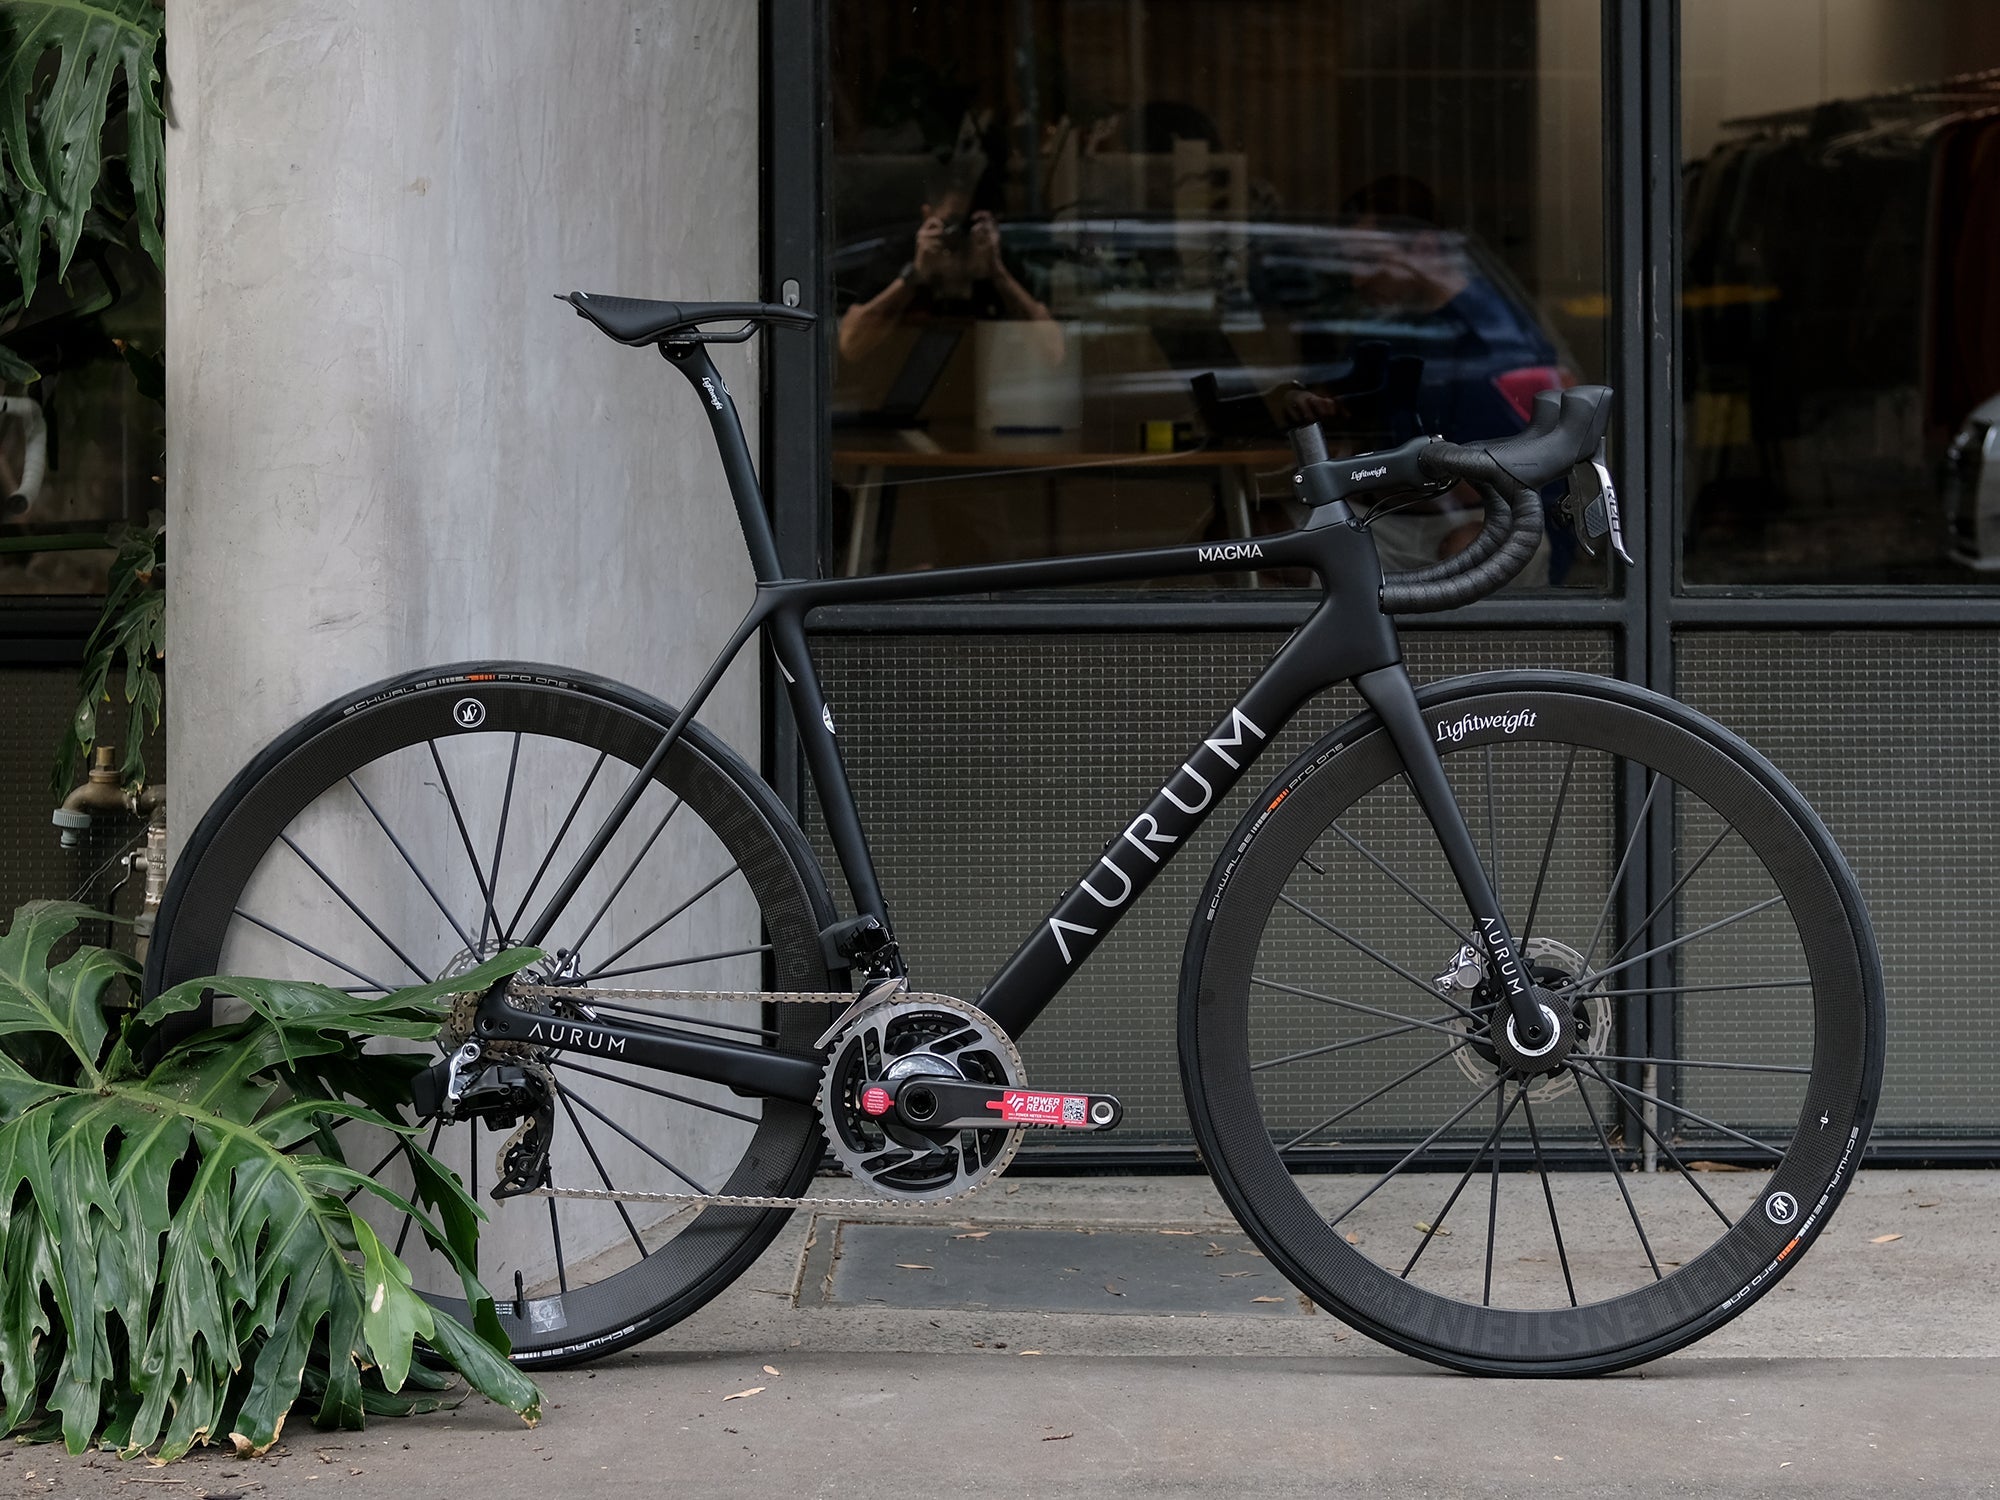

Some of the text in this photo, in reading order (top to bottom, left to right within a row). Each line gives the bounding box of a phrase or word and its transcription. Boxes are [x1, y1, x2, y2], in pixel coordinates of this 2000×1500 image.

[1350, 466, 1387, 482] Lightweight
[1198, 543, 1263, 562] MAGMA
[1436, 708, 1537, 742] Lightweight
[1049, 706, 1267, 965] AURUM
[1480, 917, 1525, 995] AURUM
[528, 1021, 627, 1054] AURUM
[1026, 1096, 1060, 1106] POWER
[1026, 1103, 1057, 1113] READY
